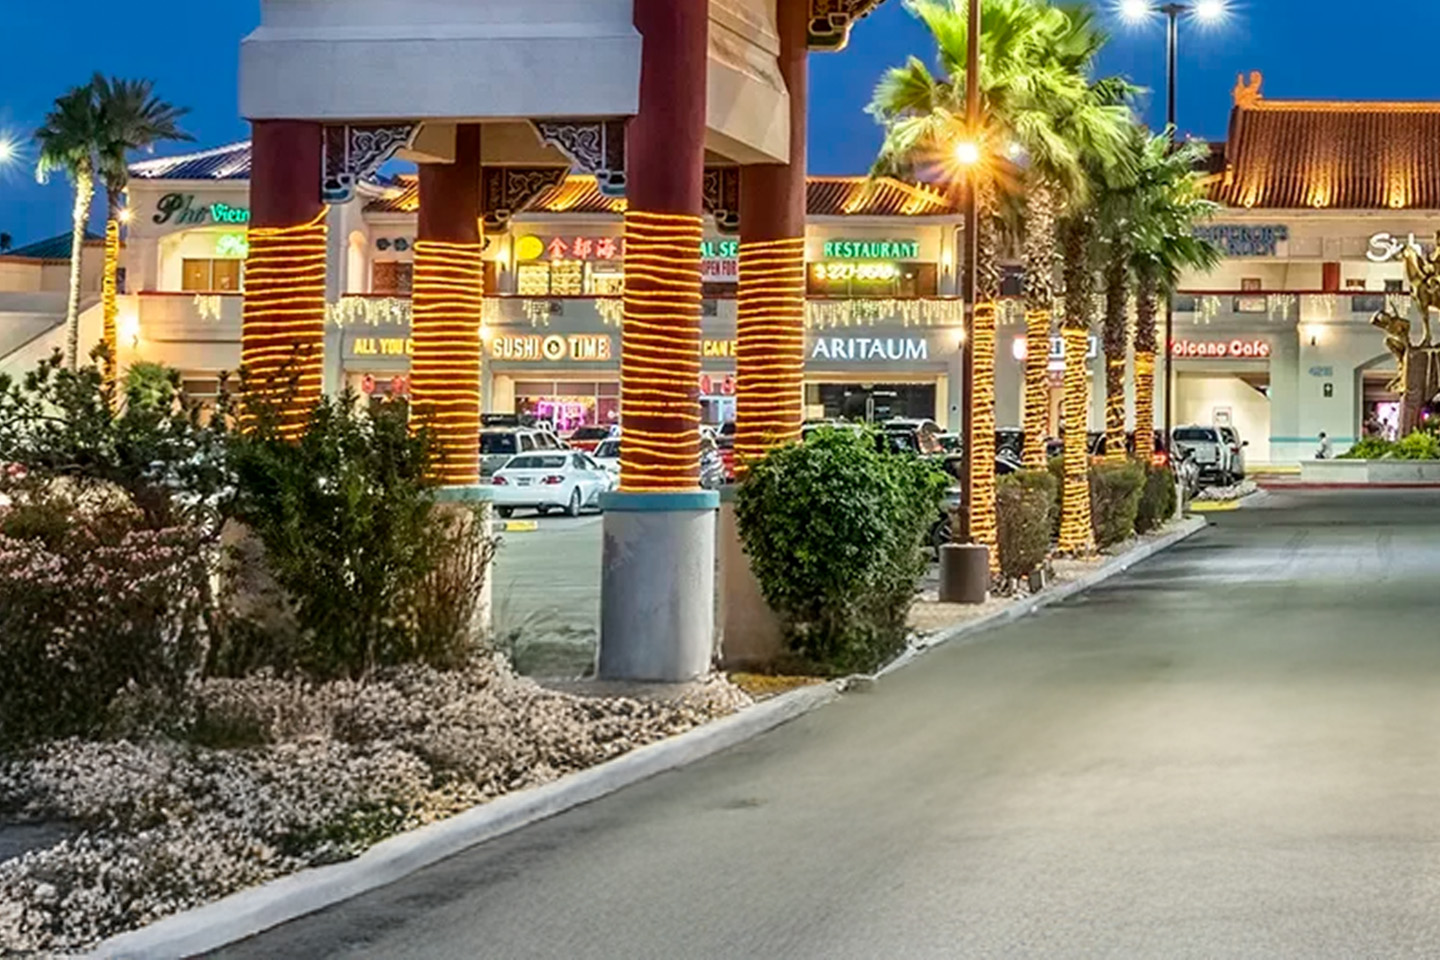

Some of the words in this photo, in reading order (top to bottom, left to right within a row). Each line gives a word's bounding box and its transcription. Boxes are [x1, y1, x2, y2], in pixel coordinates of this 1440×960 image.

[548, 237, 625, 260] 金都海
[823, 241, 920, 260] RESTAURANT
[354, 339, 378, 355] ALL
[380, 339, 405, 355] YOU
[493, 337, 540, 358] SUSHI
[569, 337, 609, 358] TIME
[812, 338, 928, 360] ARITAUM
[1229, 340, 1270, 357] Cafe
